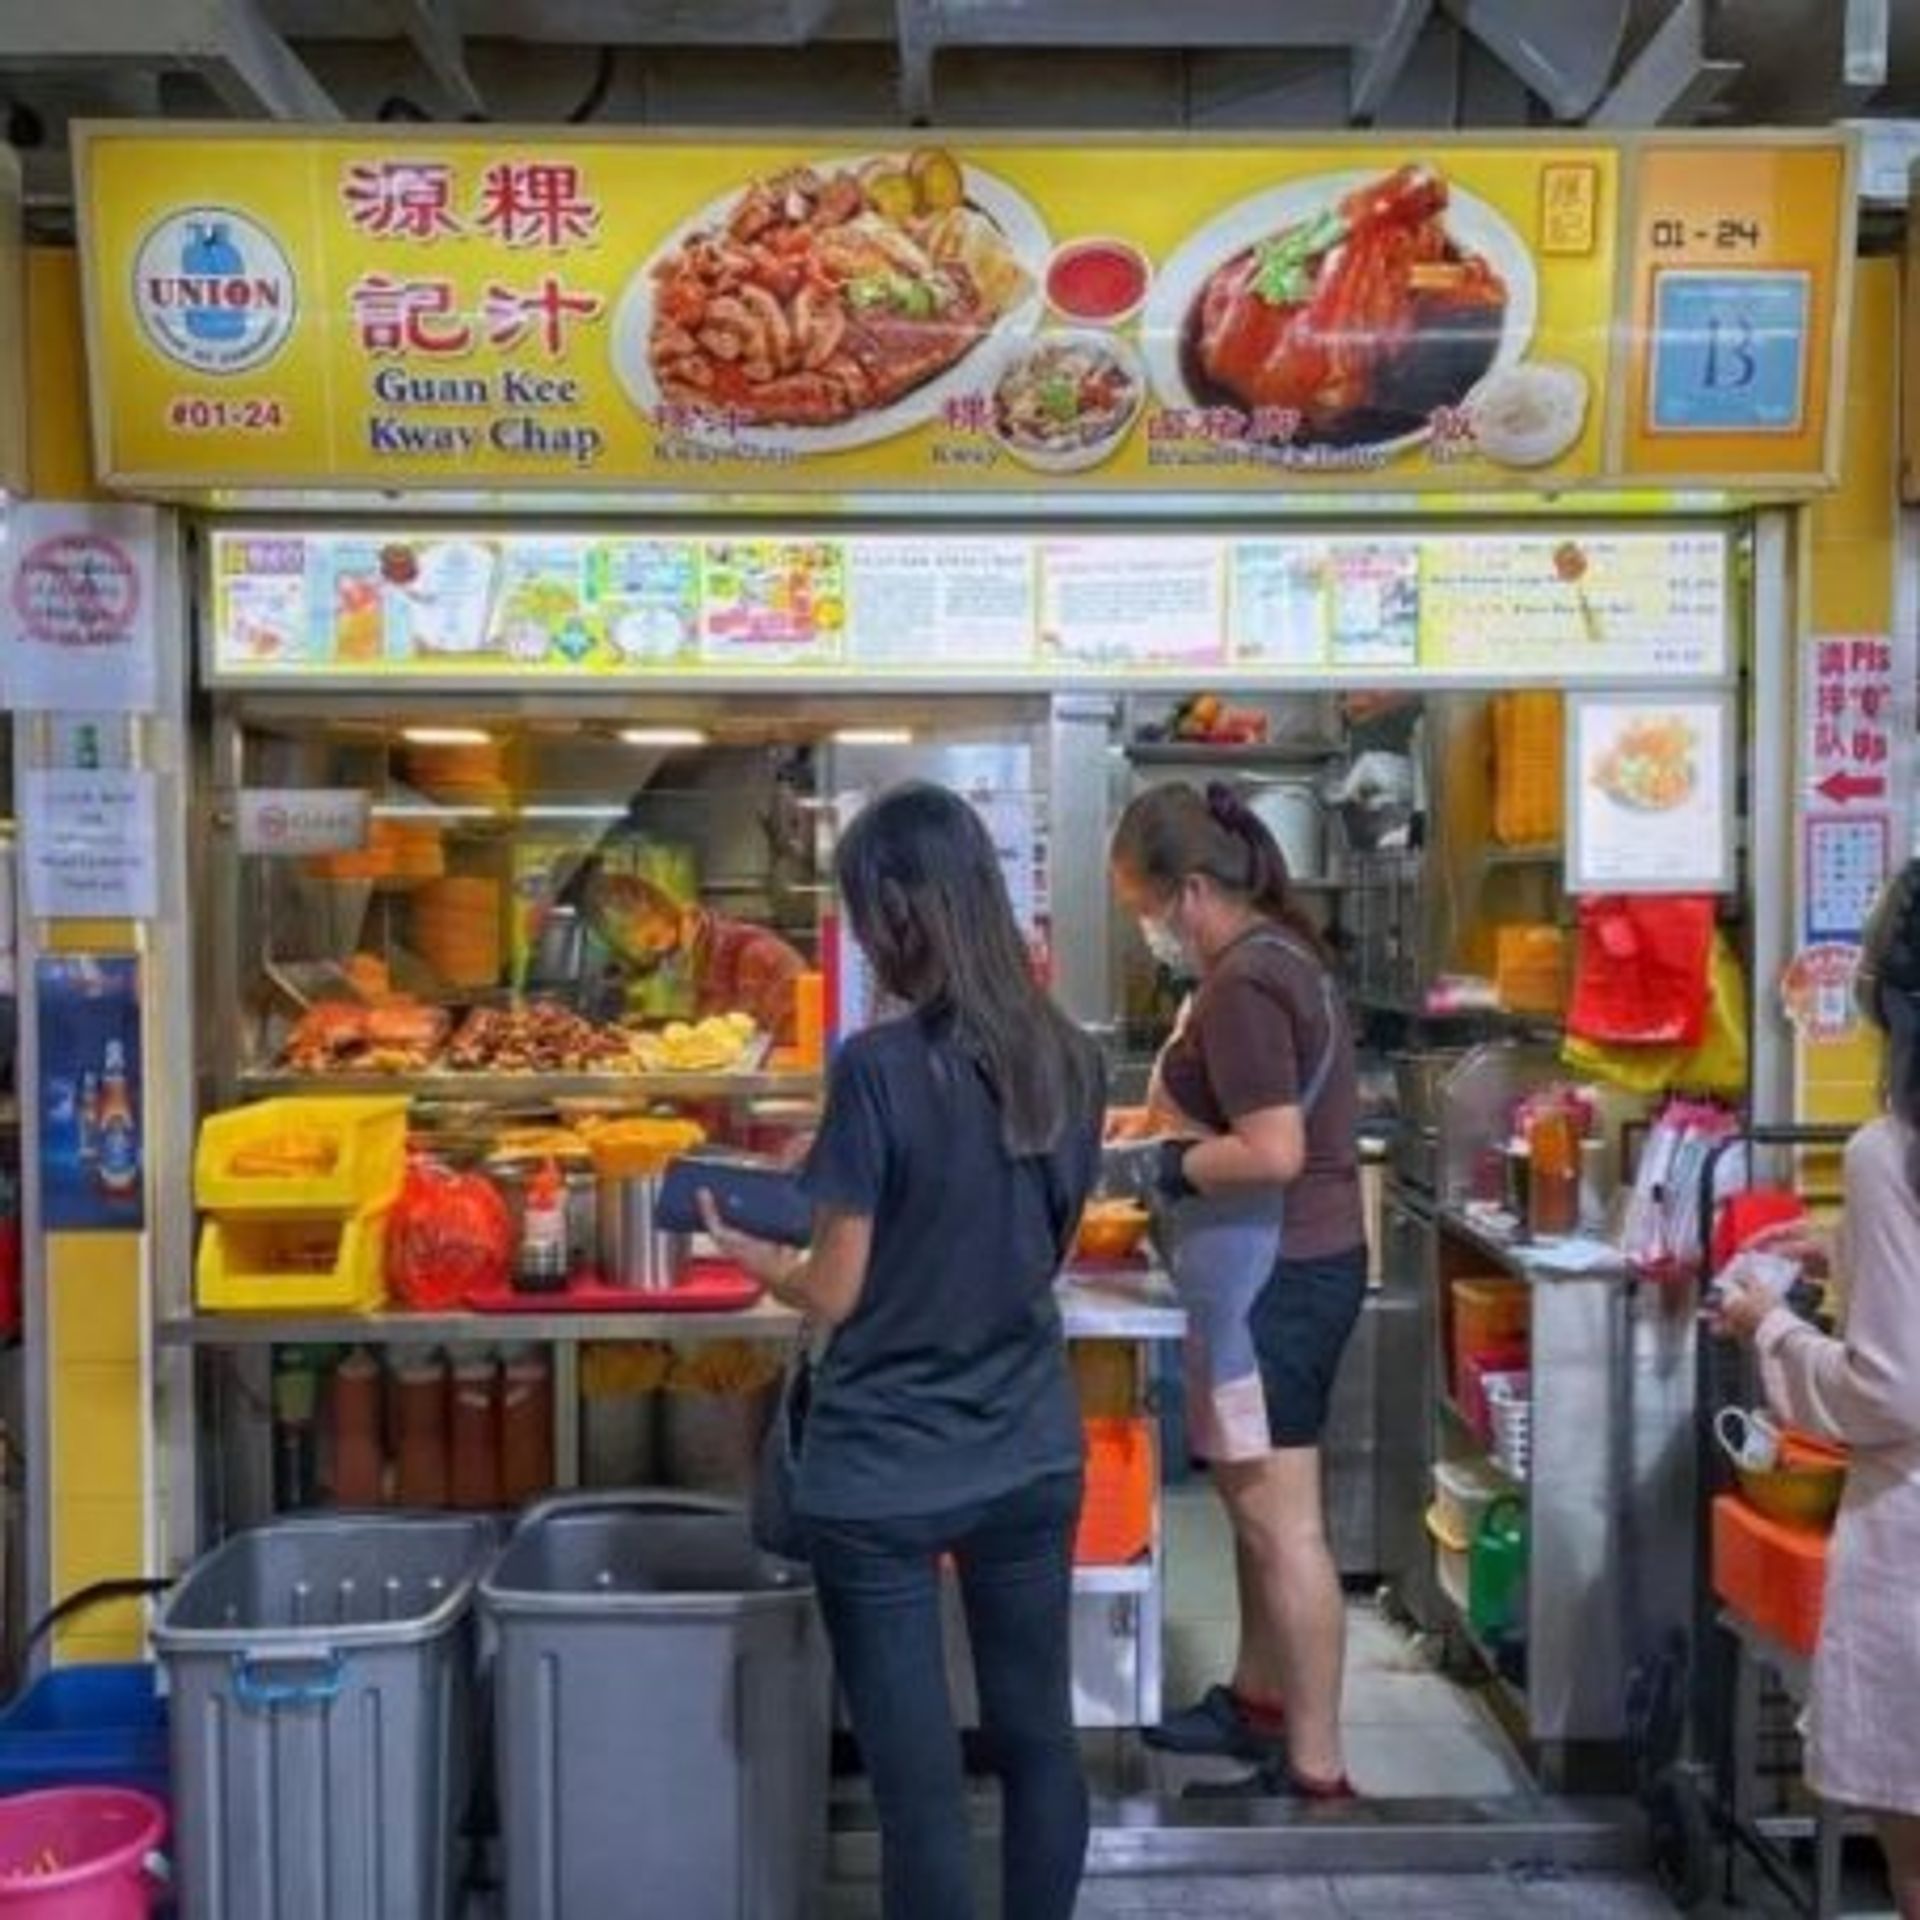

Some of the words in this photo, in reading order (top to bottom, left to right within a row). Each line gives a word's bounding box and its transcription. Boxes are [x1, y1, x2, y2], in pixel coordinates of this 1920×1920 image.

[148, 278, 281, 309] UNION
[374, 369, 488, 406] Guan
[490, 419, 603, 467] Chap
